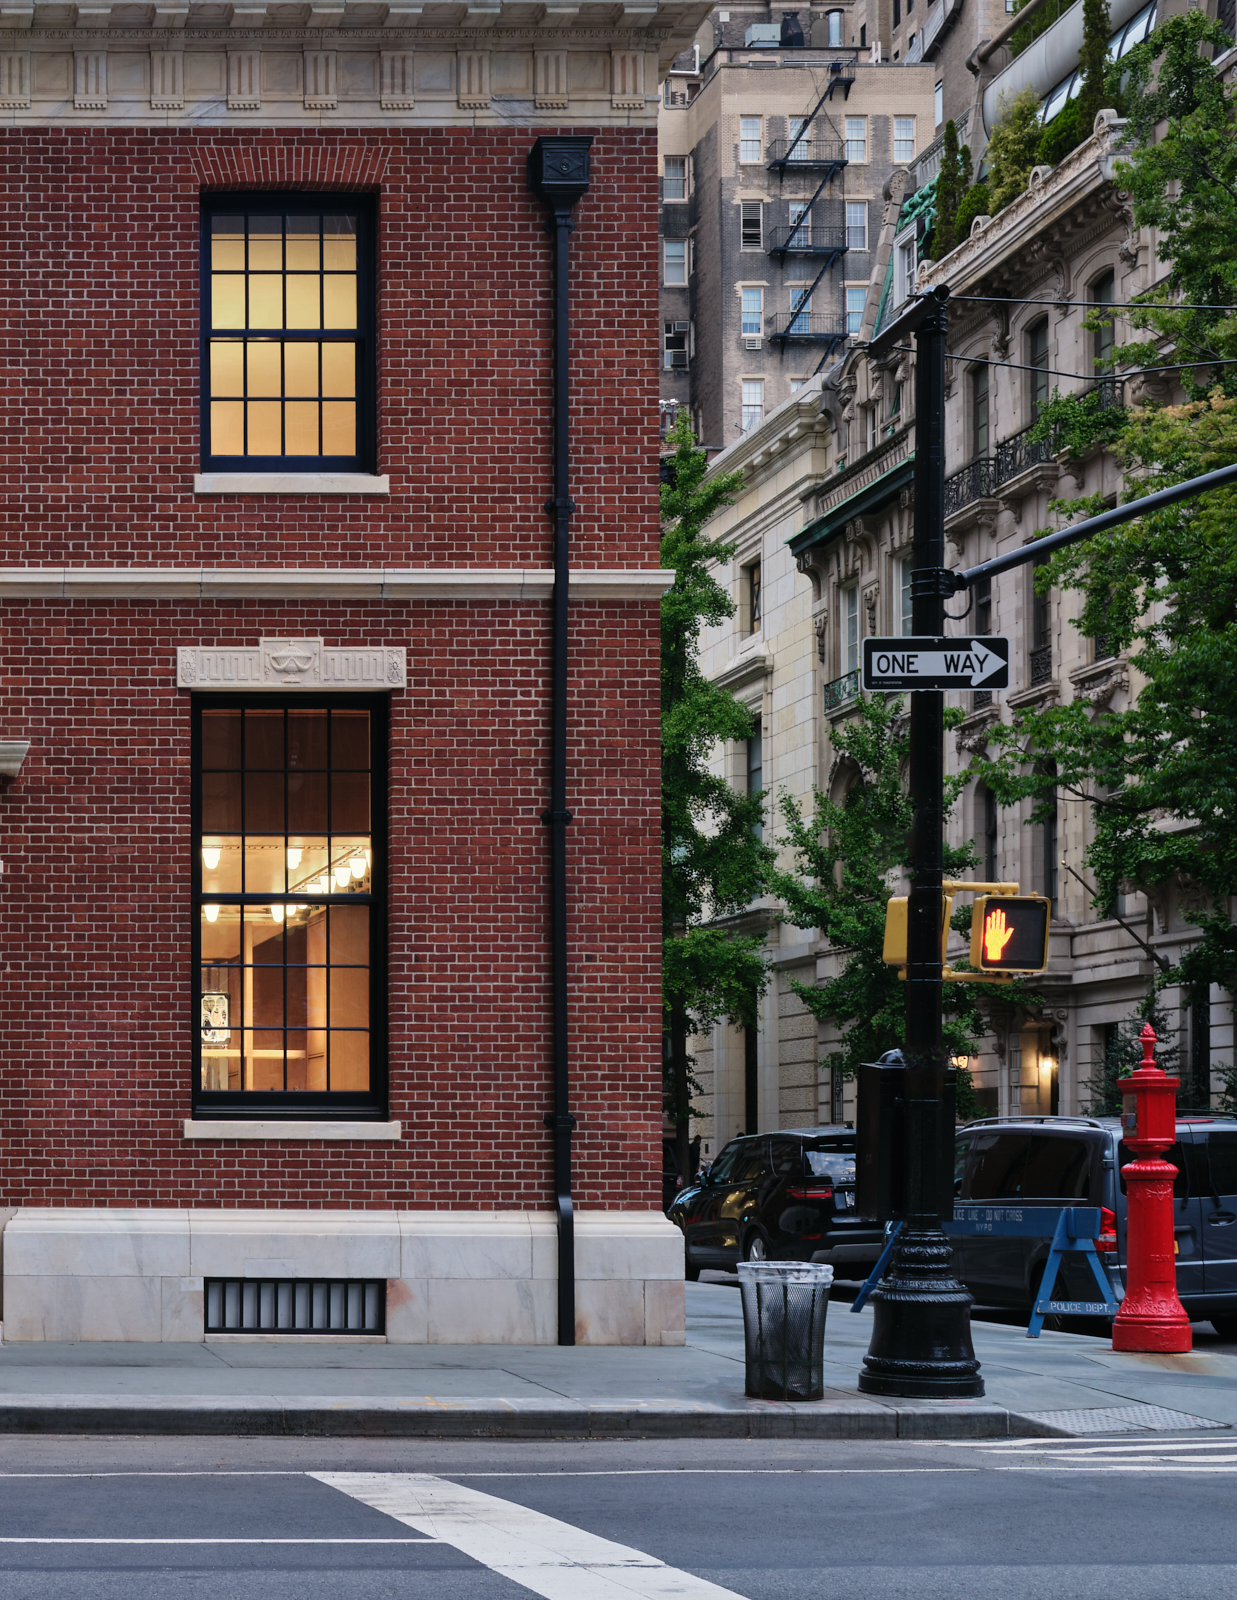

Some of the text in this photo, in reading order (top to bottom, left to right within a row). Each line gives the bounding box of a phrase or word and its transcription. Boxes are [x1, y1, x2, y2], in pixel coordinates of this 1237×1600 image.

[877, 654, 989, 674] ONE WAY
[953, 1209, 965, 1221] LICE
[967, 1209, 979, 1221] LINE
[985, 1209, 993, 1221] DO
[994, 1209, 1004, 1221] NOT
[1006, 1210, 1023, 1222] CROSS
[975, 1223, 993, 1231] NYPD
[1050, 1302, 1111, 1313] POLICE DEPT.
